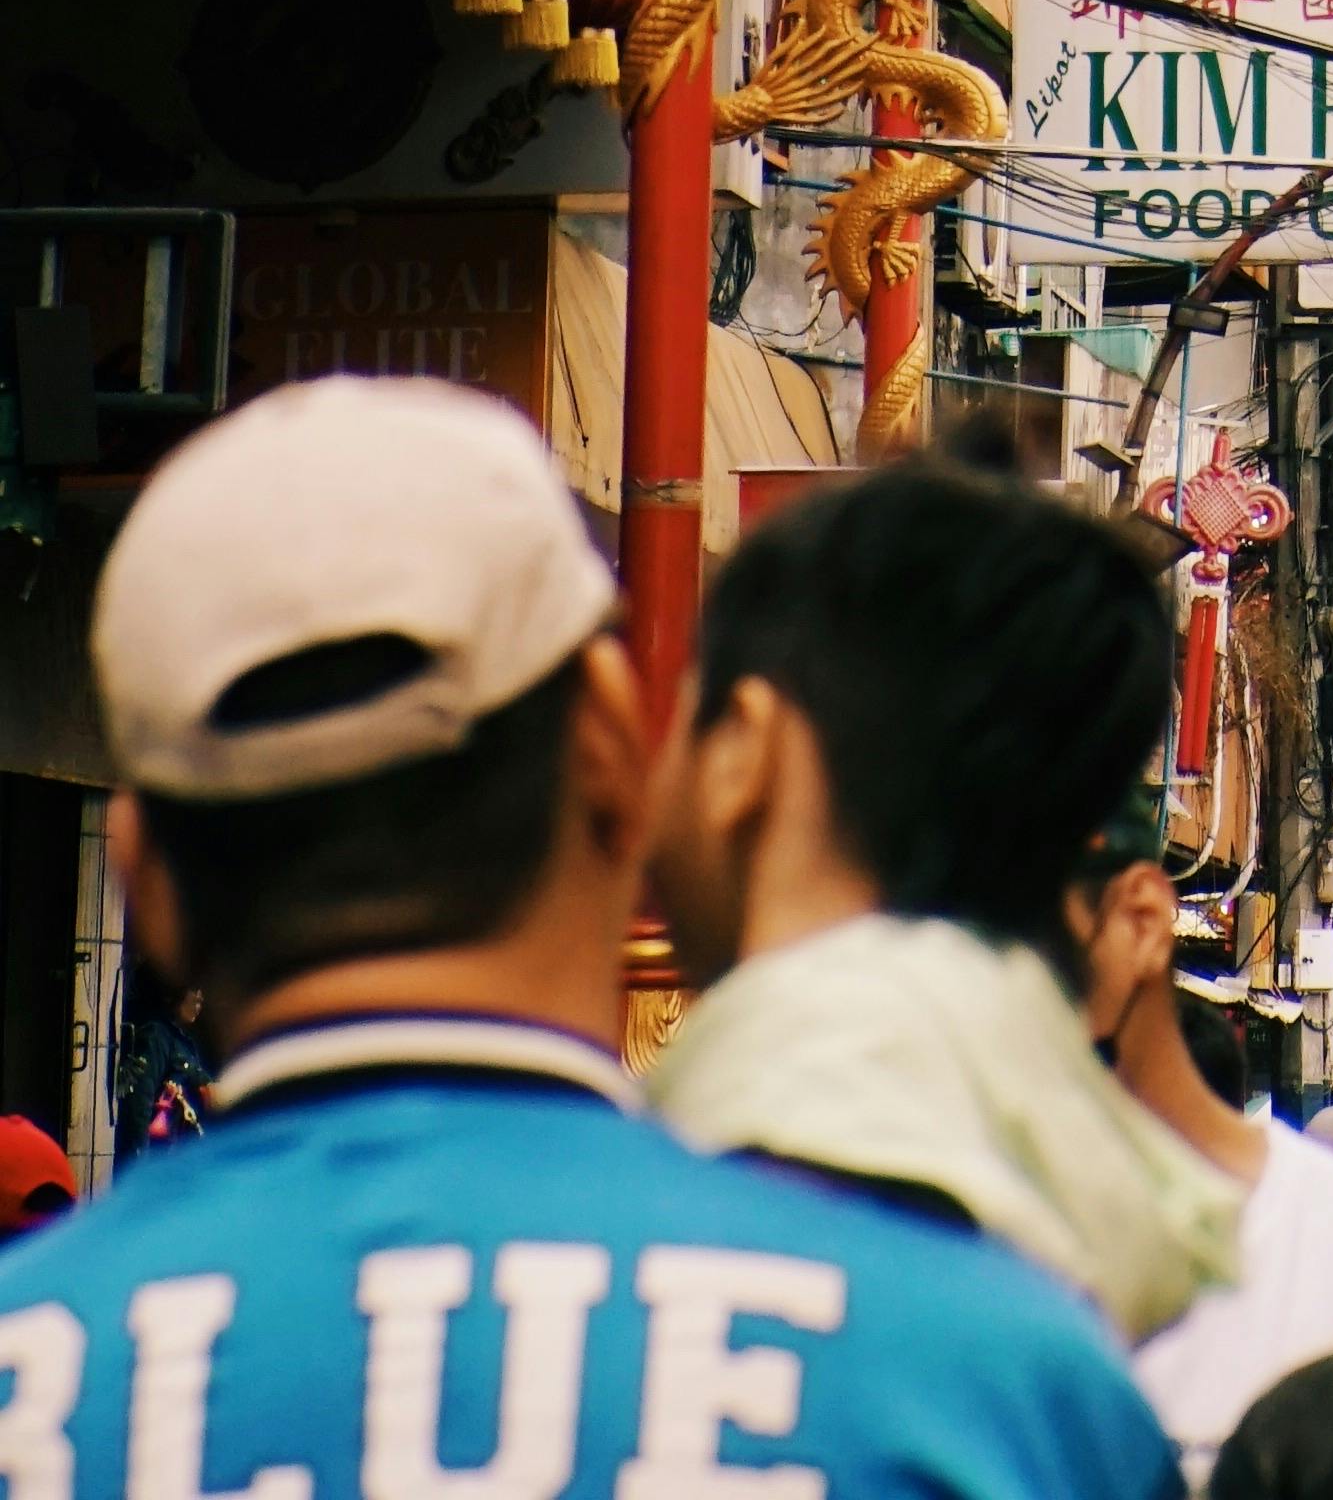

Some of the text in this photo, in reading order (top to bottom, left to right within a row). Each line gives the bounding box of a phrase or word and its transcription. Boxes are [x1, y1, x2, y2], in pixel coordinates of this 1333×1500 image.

[1082, 49, 1278, 173] KIM
[1093, 188, 1275, 241] FOOD
[241, 258, 534, 322] GLOBAL
